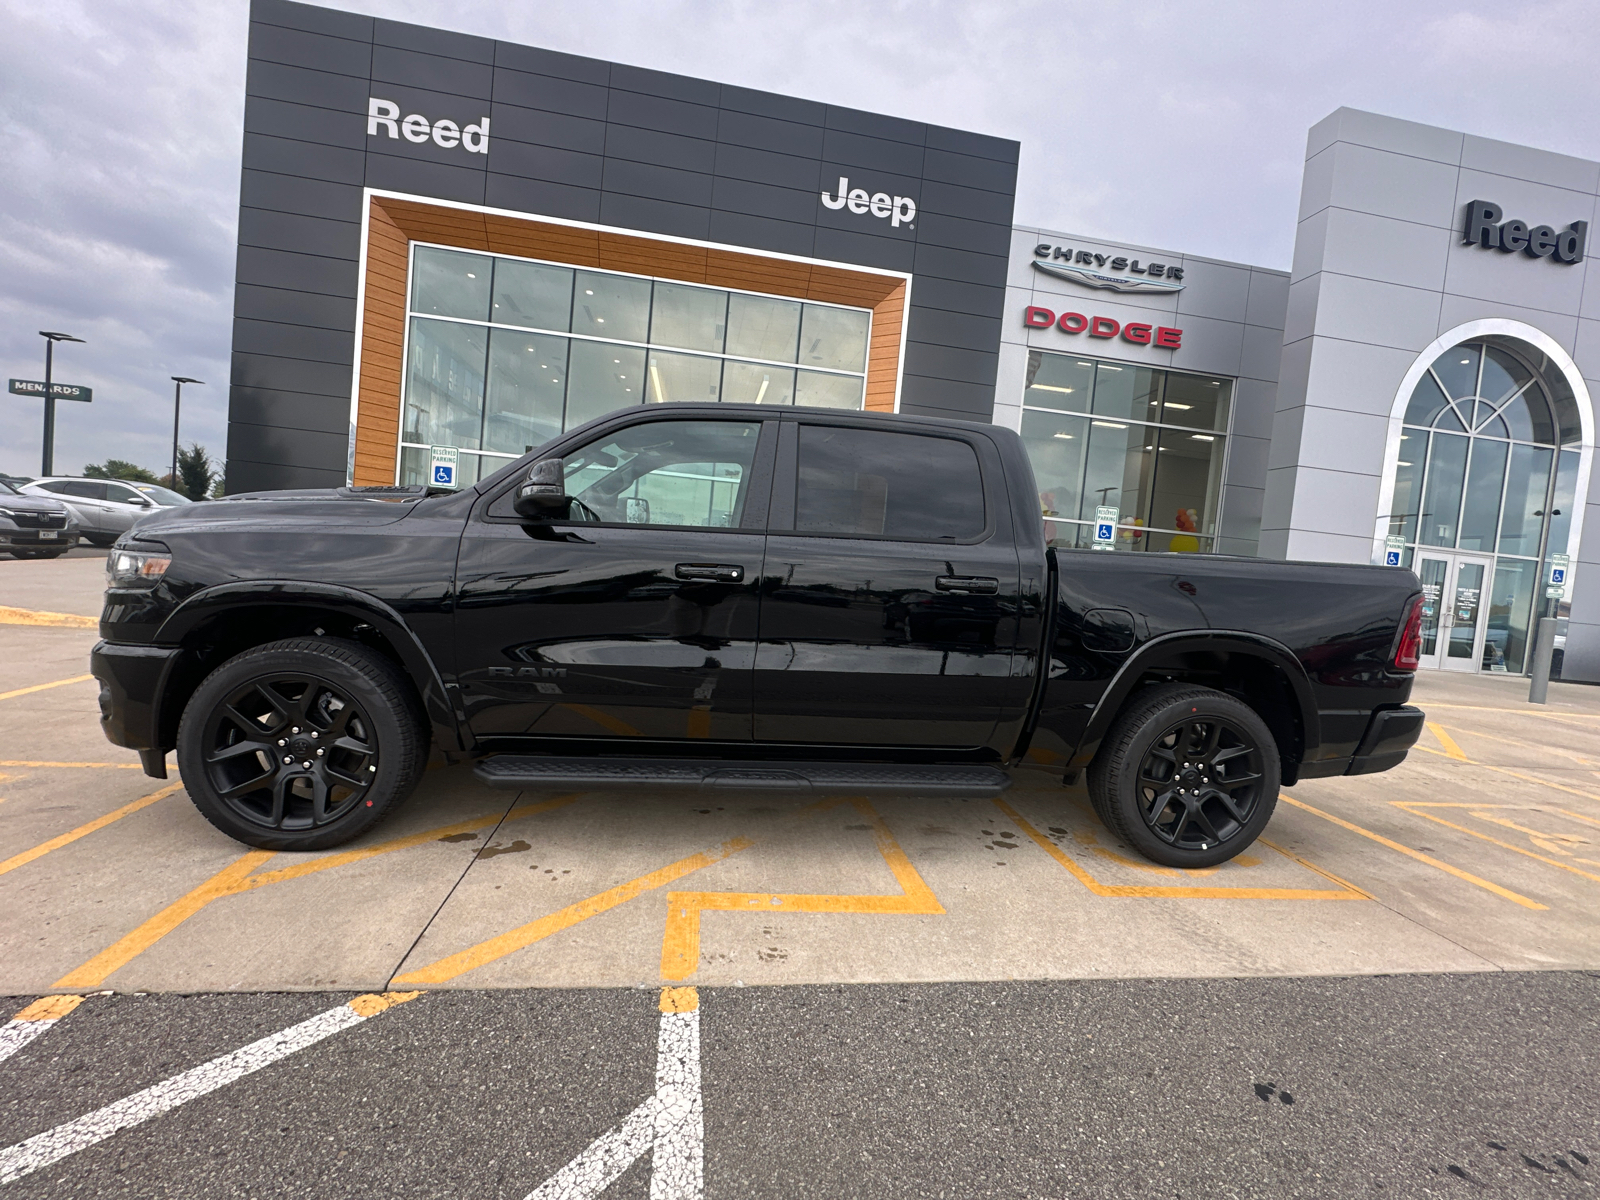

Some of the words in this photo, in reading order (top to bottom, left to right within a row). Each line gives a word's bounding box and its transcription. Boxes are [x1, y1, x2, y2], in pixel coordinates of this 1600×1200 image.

[367, 97, 491, 155] Reed
[821, 176, 916, 228] Jeep
[1463, 199, 1588, 265] Reed
[1034, 243, 1185, 280] CHRYSLER
[1023, 305, 1183, 350] DODGE
[488, 666, 567, 678] RAM
